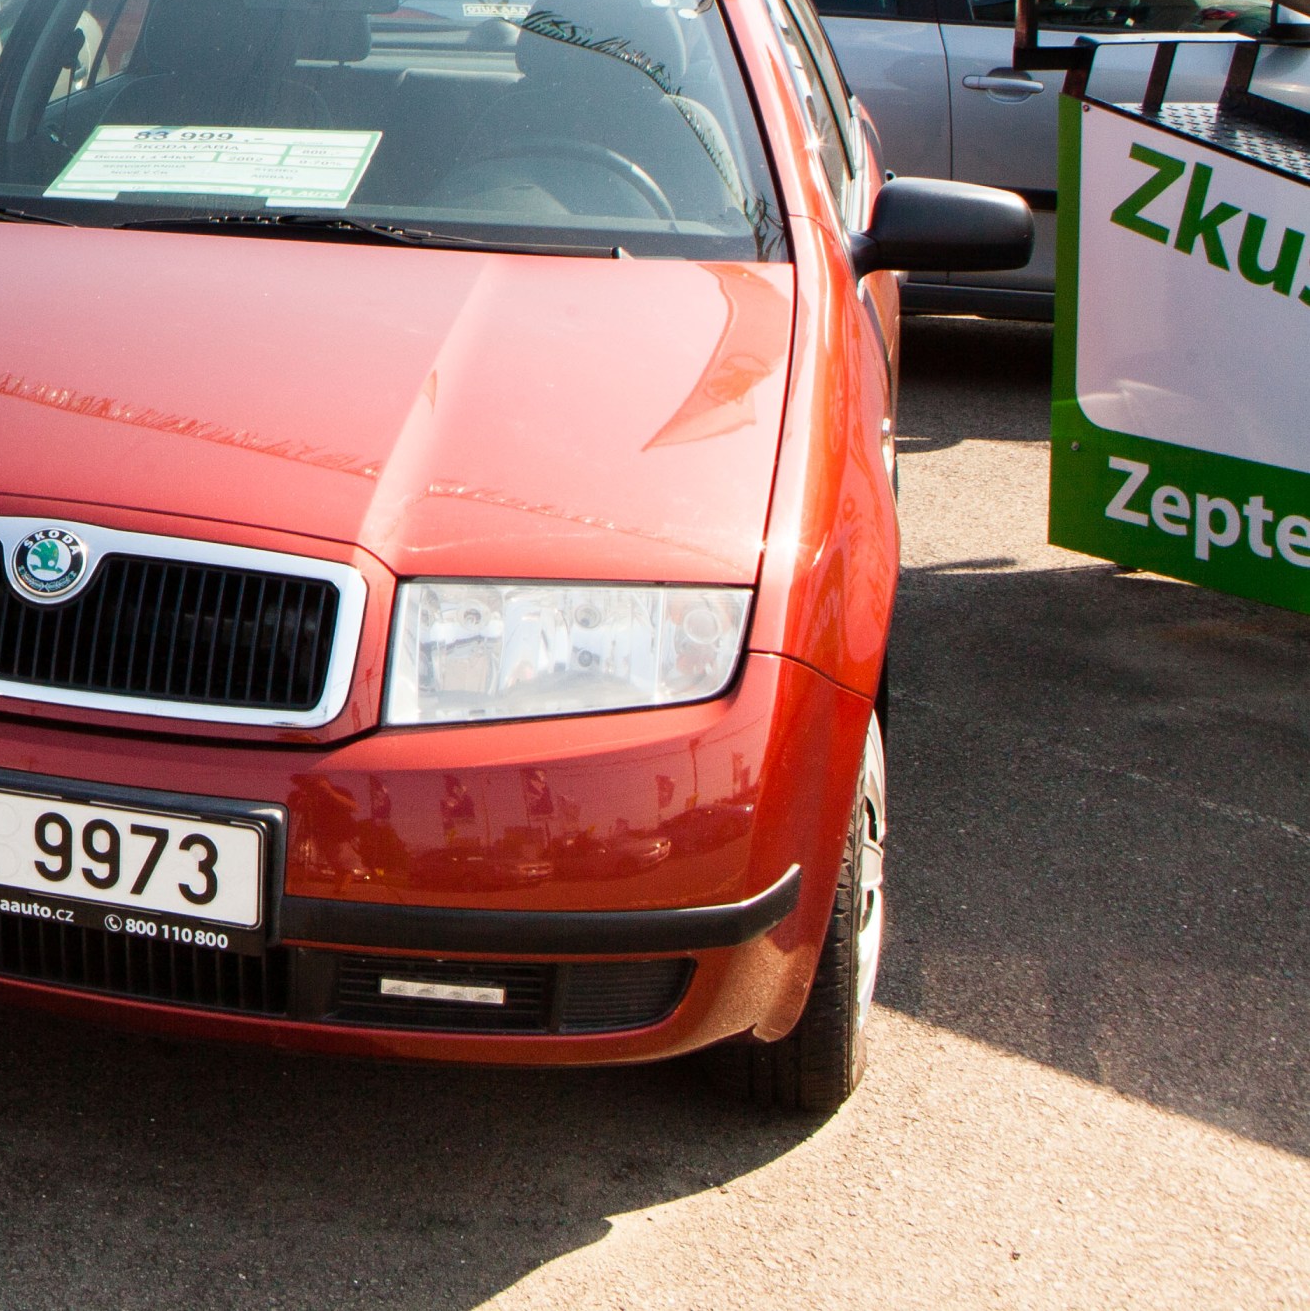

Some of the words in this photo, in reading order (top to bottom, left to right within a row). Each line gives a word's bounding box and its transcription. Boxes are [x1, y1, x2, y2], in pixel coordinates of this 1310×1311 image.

[134, 130, 170, 141] 83
[181, 132, 234, 141] 999
[1109, 141, 1310, 307] Zku
[34, 811, 219, 906] 9973
[125, 918, 157, 937] 800
